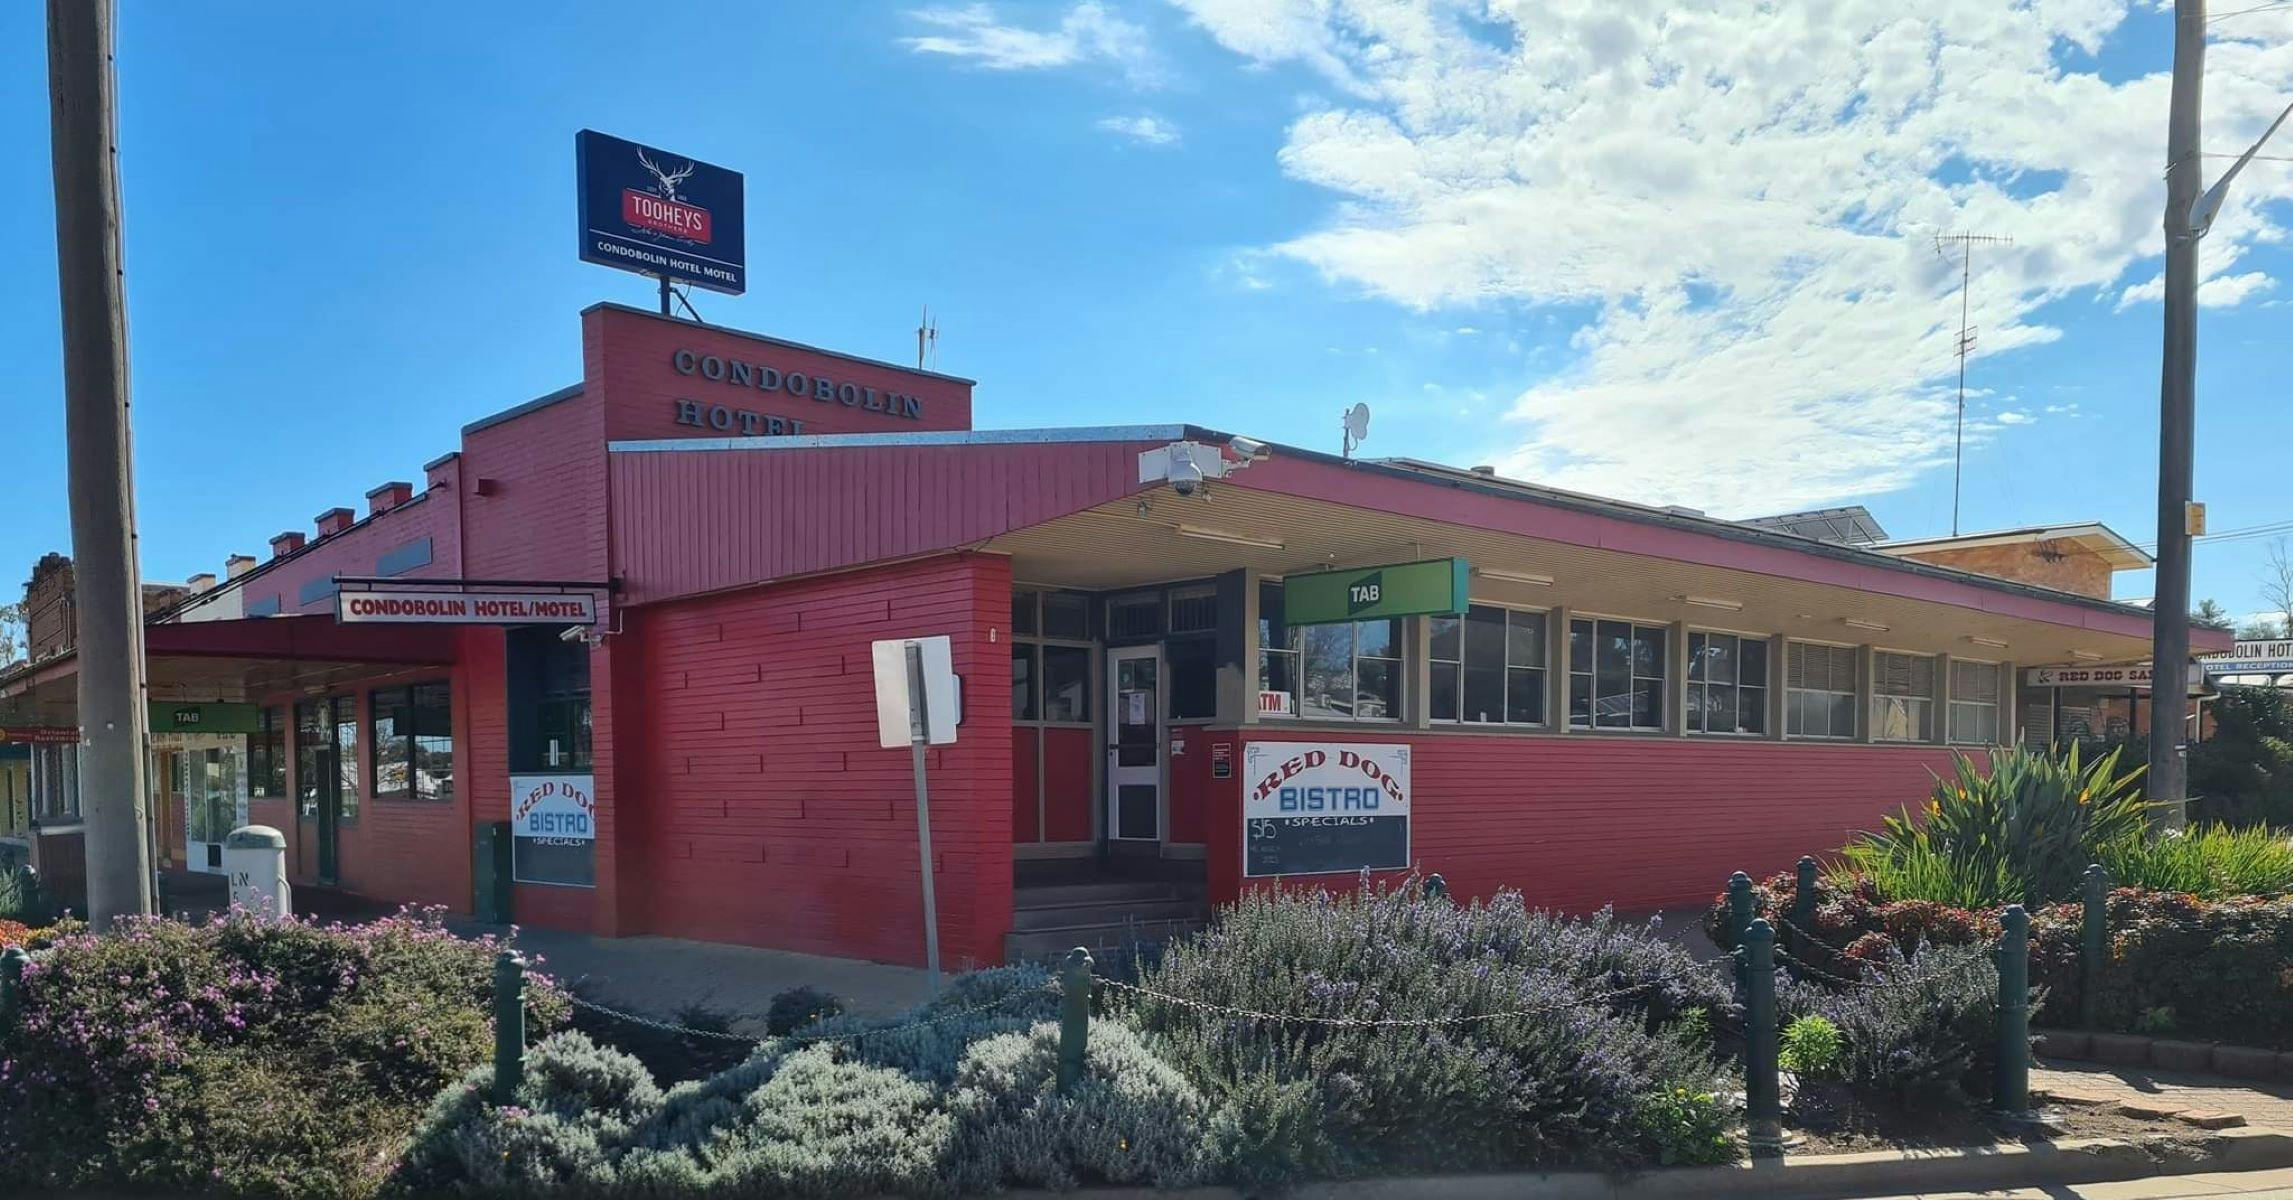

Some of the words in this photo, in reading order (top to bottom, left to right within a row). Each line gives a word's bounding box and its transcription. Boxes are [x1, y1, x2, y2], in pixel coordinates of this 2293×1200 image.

[632, 196, 702, 231] TOOHEYS
[597, 241, 667, 266] CONDOBOLIN
[670, 259, 701, 274] HOTEL
[704, 266, 737, 282] MOTEL
[673, 349, 922, 420] CONDOBOLIN
[1350, 585, 1379, 602] TAB
[350, 599, 466, 616] CONDOBOLIN
[474, 600, 587, 617] HOTEL/MOTEL
[2268, 642, 2293, 657] HOT
[2059, 670, 2089, 682] RED
[2094, 670, 2123, 681] DOG
[2205, 663, 2232, 672] OTEL
[176, 712, 200, 723] TAB
[1256, 750, 1326, 800] RED
[1340, 750, 1400, 800] DOG
[518, 781, 555, 820] RED
[1280, 786, 1380, 812] BISTRO
[530, 812, 588, 833] BISTRO
[1291, 816, 1368, 827] SPECIALS
[537, 836, 582, 847] SPECIALS
